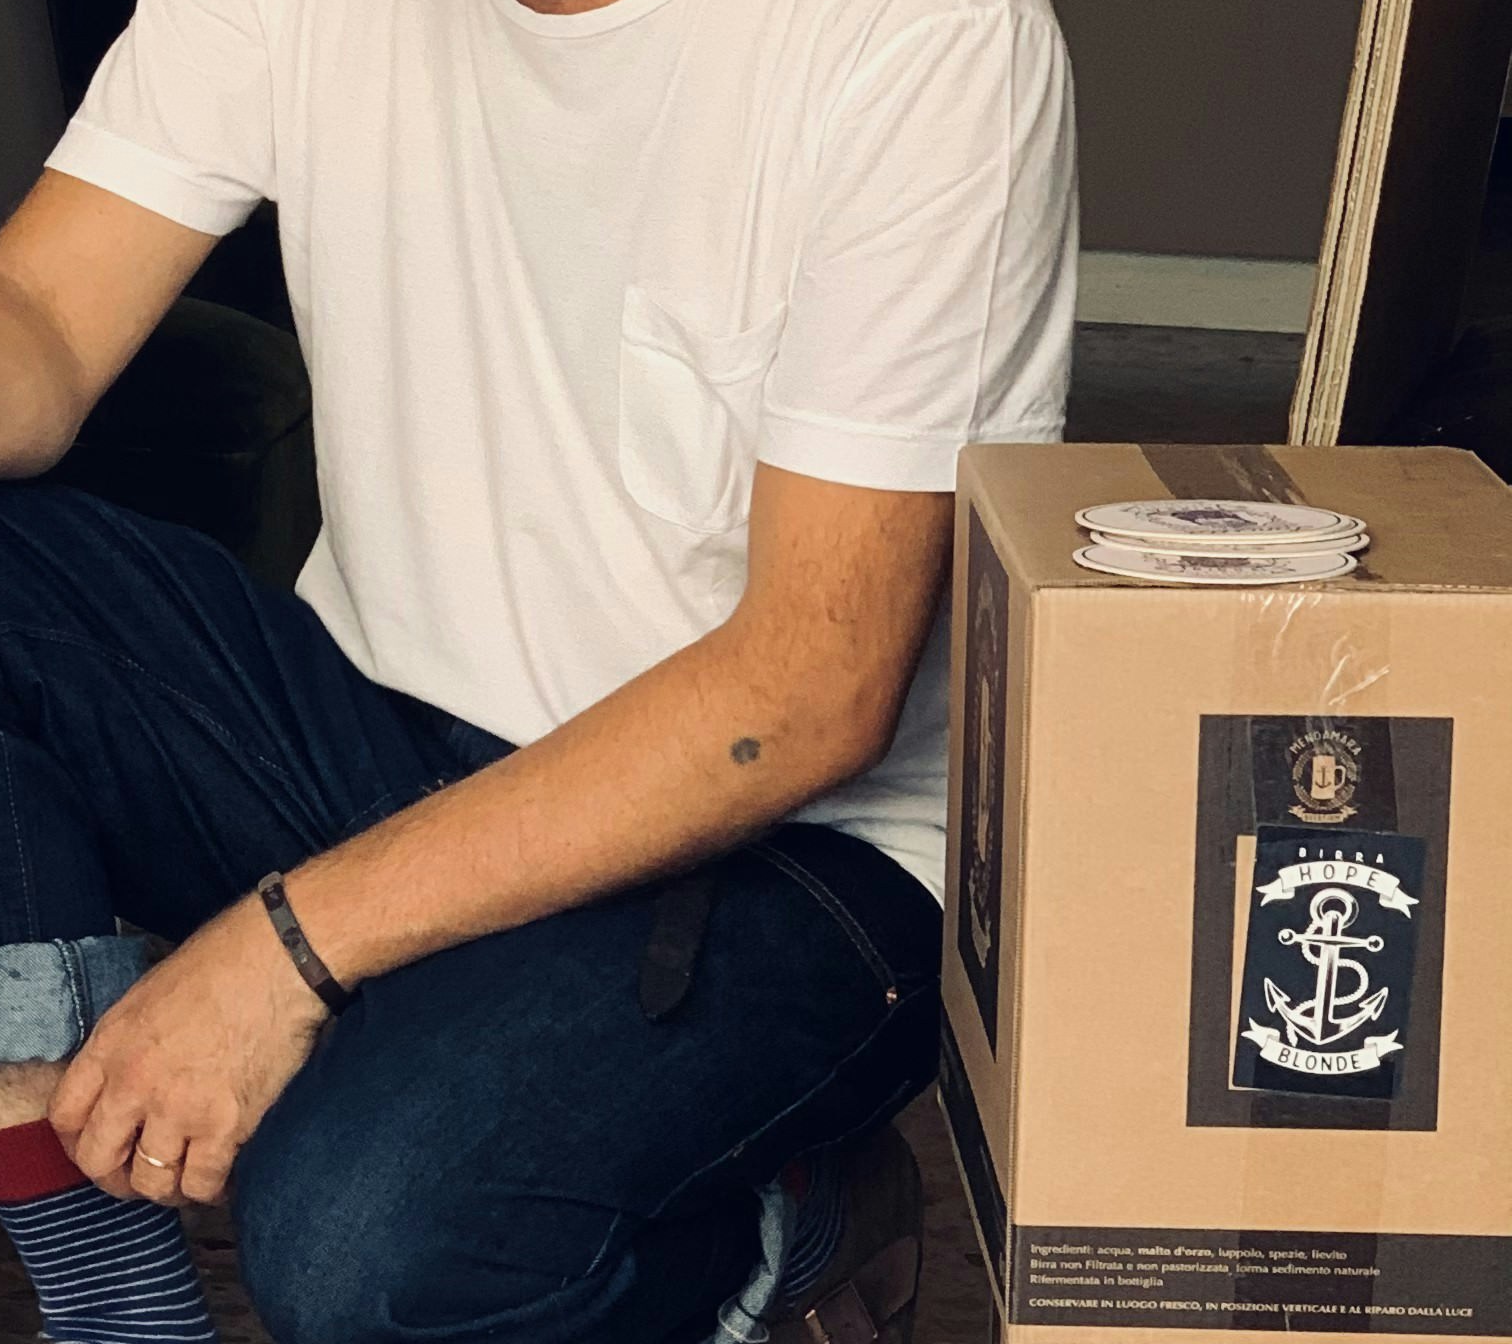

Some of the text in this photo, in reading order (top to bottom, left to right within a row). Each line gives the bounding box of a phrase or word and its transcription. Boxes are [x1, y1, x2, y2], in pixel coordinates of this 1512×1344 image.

[1289, 730, 1362, 756] MENOAMARA
[1298, 847, 1384, 864] BIRRA
[1299, 863, 1380, 888] HOPE
[1277, 1047, 1362, 1072] BLONDE
[1097, 1246, 1135, 1257] acqua,
[1138, 1245, 1172, 1257] malto
[1174, 1246, 1215, 1258] d'orzo,
[1218, 1247, 1266, 1260] luppolo,
[1268, 1249, 1309, 1261] spezie,
[1311, 1249, 1348, 1260] lievito
[1030, 1258, 1057, 1270] Birra
[1060, 1260, 1083, 1271] non
[1126, 1263, 1134, 1272] e
[1136, 1263, 1159, 1272] non
[1235, 1263, 1269, 1274] forma
[1272, 1264, 1331, 1276] sedimento
[1333, 1266, 1381, 1277] naturale
[1029, 1274, 1164, 1289] Rifermentata in bottiglia
[1028, 1297, 1099, 1308] CONSERVARE
[1101, 1299, 1114, 1309] IN
[1116, 1299, 1158, 1310] LUOGO
[1159, 1300, 1203, 1312] FRESCO,
[1205, 1302, 1219, 1311] IN
[1220, 1301, 1280, 1313] POSIZIONE
[1281, 1303, 1337, 1314] VERTICALE
[1348, 1305, 1362, 1315] AL
[1364, 1305, 1406, 1316] RIPARO
[1407, 1306, 1443, 1317] DALLA
[1445, 1307, 1474, 1318] LUCE
